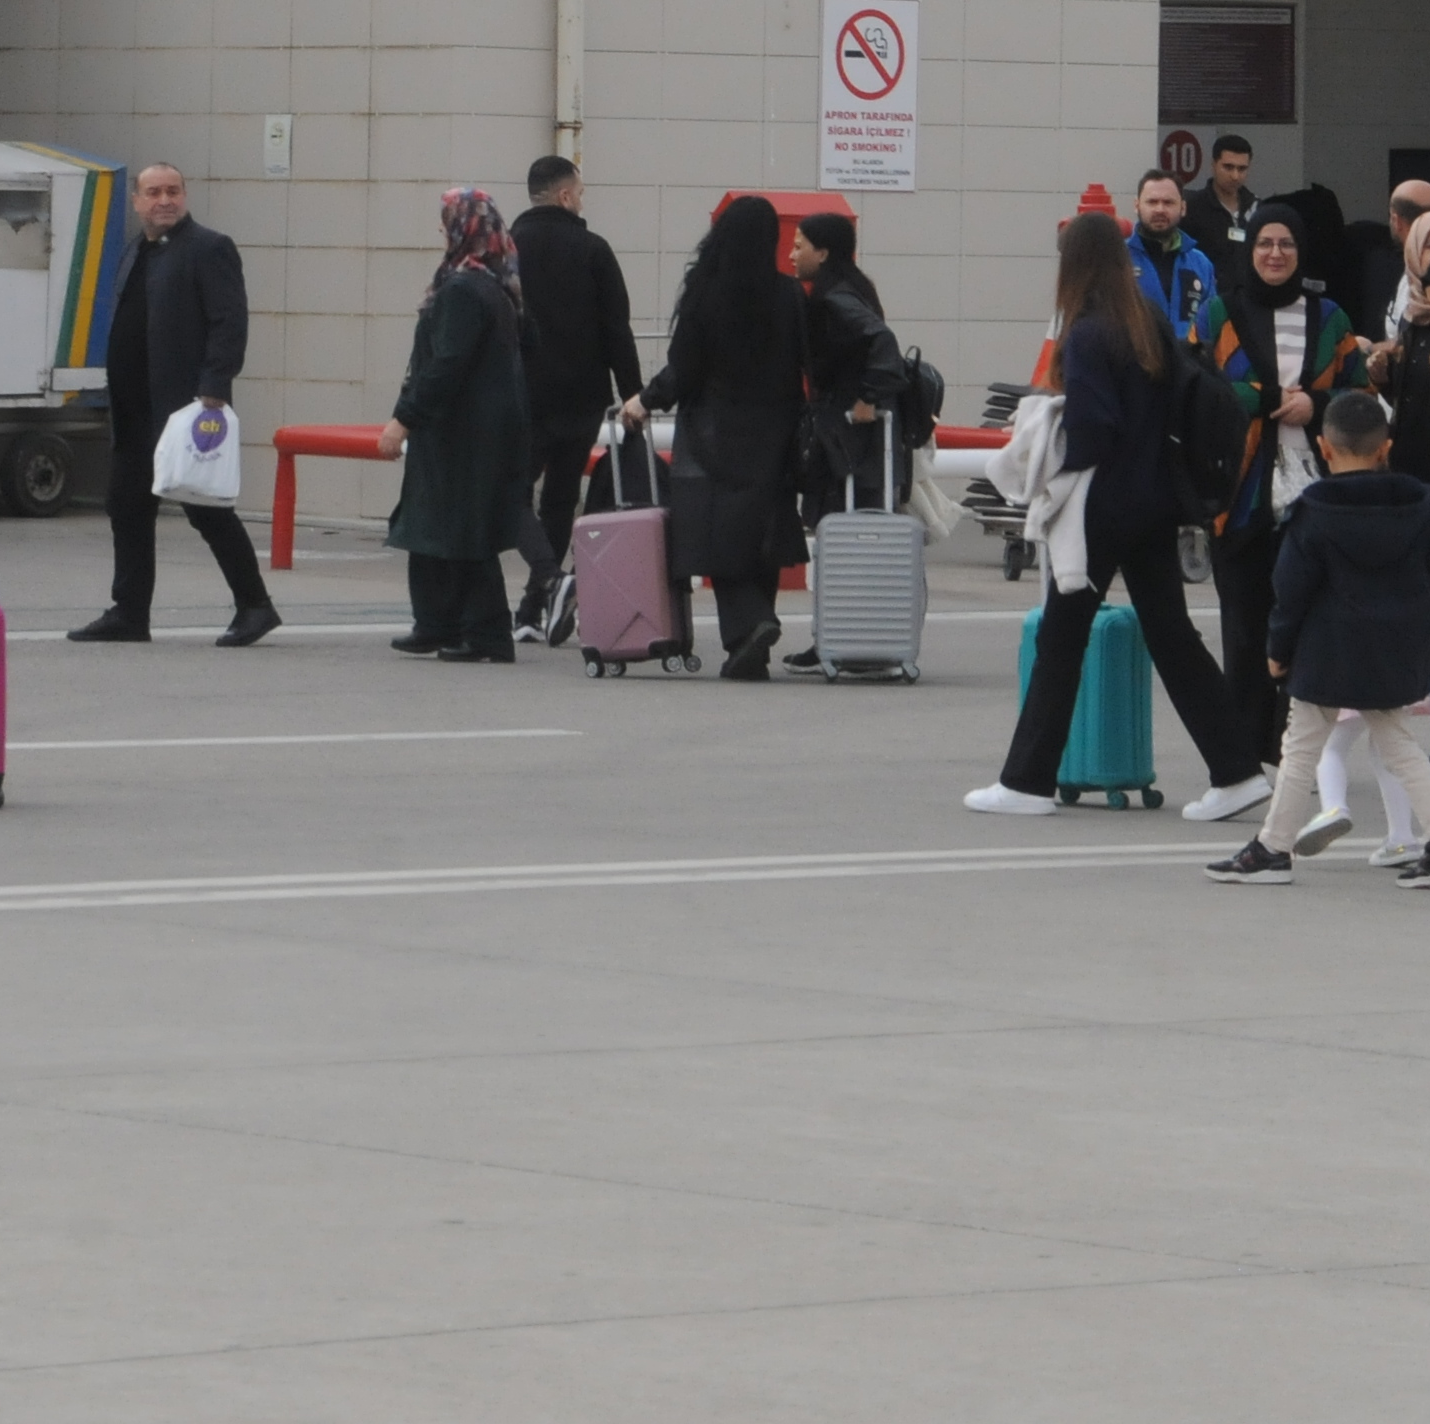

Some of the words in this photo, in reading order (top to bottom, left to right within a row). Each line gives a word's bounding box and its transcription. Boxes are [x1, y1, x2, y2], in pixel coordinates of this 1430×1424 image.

[824, 111, 857, 121] APRON
[860, 111, 914, 122] TARAFINDA
[827, 125, 863, 136] SİGARA
[866, 125, 905, 138] İÇİLMEZ
[834, 142, 849, 151] NO
[1167, 142, 1197, 173] 10
